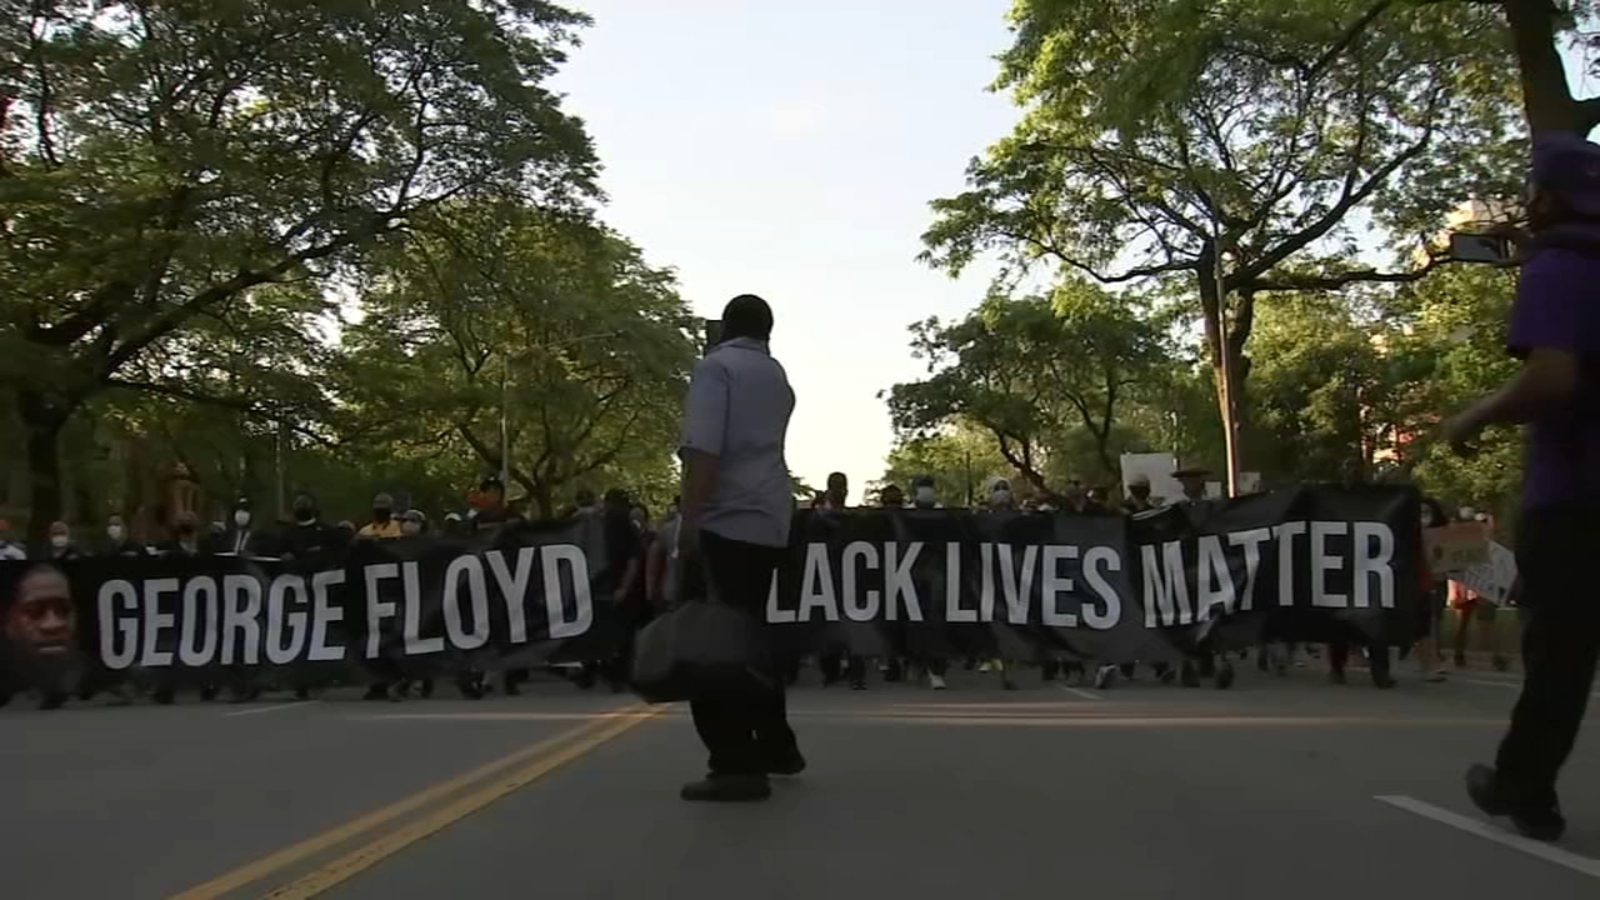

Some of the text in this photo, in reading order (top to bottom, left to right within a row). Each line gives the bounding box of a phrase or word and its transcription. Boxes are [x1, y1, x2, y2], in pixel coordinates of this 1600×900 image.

[98, 544, 593, 669] GEORGE FLOYD
[765, 520, 1395, 631] LACK LIVES MATTER
